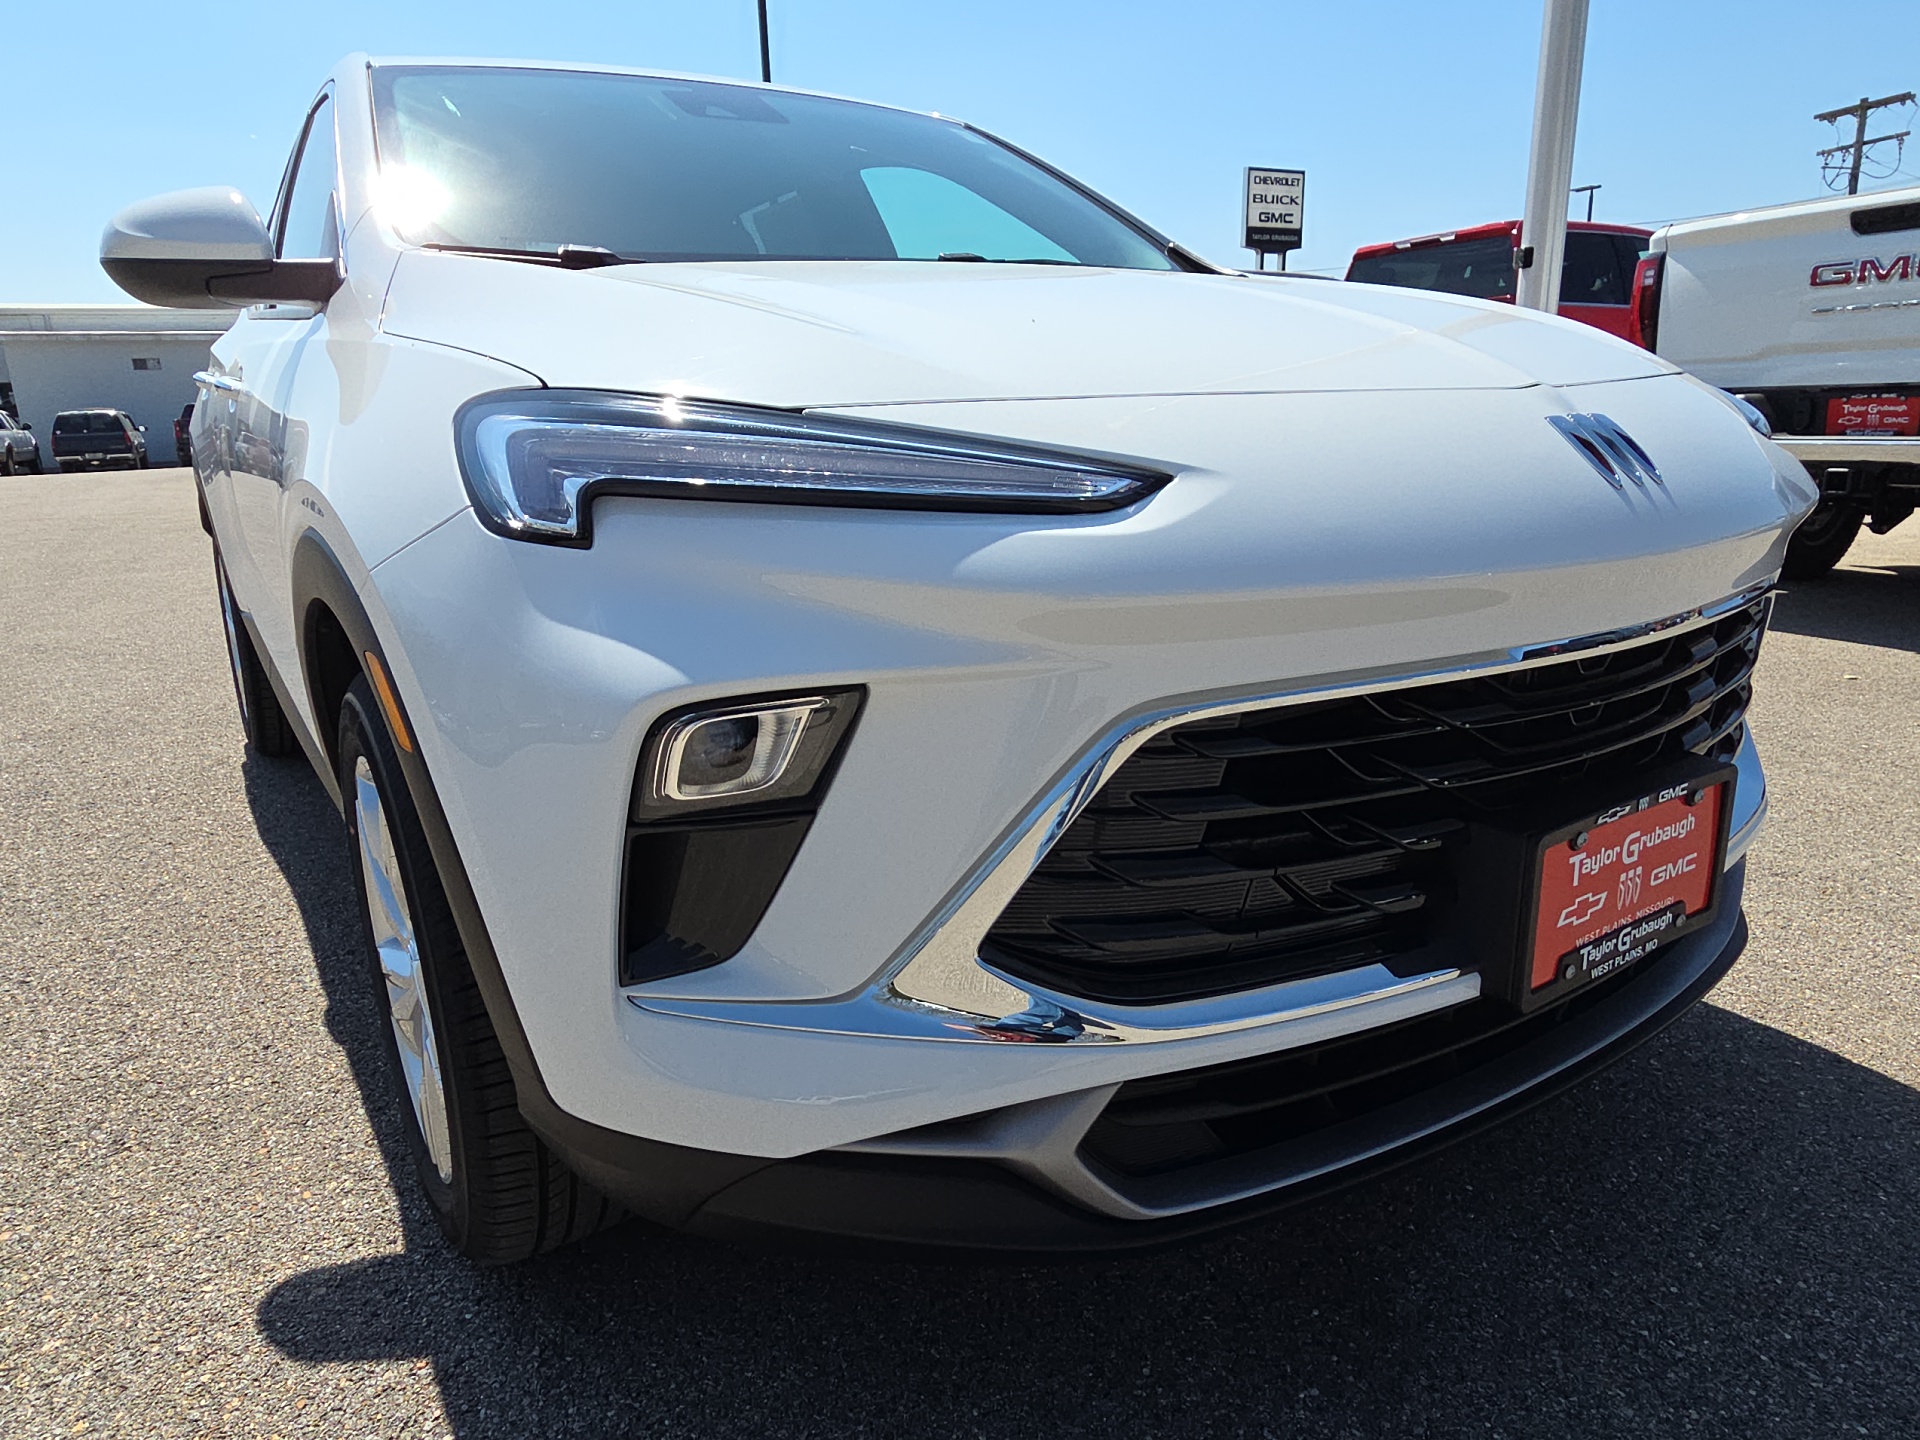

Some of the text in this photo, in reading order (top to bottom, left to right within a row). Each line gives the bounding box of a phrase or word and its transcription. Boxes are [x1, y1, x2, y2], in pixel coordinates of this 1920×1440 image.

[1254, 176, 1301, 187] CHEVROLET
[1253, 194, 1300, 205] BUICK
[1258, 212, 1294, 224] GMC
[1809, 254, 1920, 287] GM
[1842, 405, 1867, 414] Taylor
[1658, 782, 1689, 803] GMC
[1569, 813, 1696, 886] Taylor Grubaugh
[1650, 853, 1698, 887] GMC
[1576, 931, 1600, 947] WEST
[1635, 896, 1674, 920] MISSOURI
[1580, 911, 1673, 971] Taylor Grubaugh
[1591, 961, 1614, 980] WEST
[1645, 938, 1658, 954] MO
